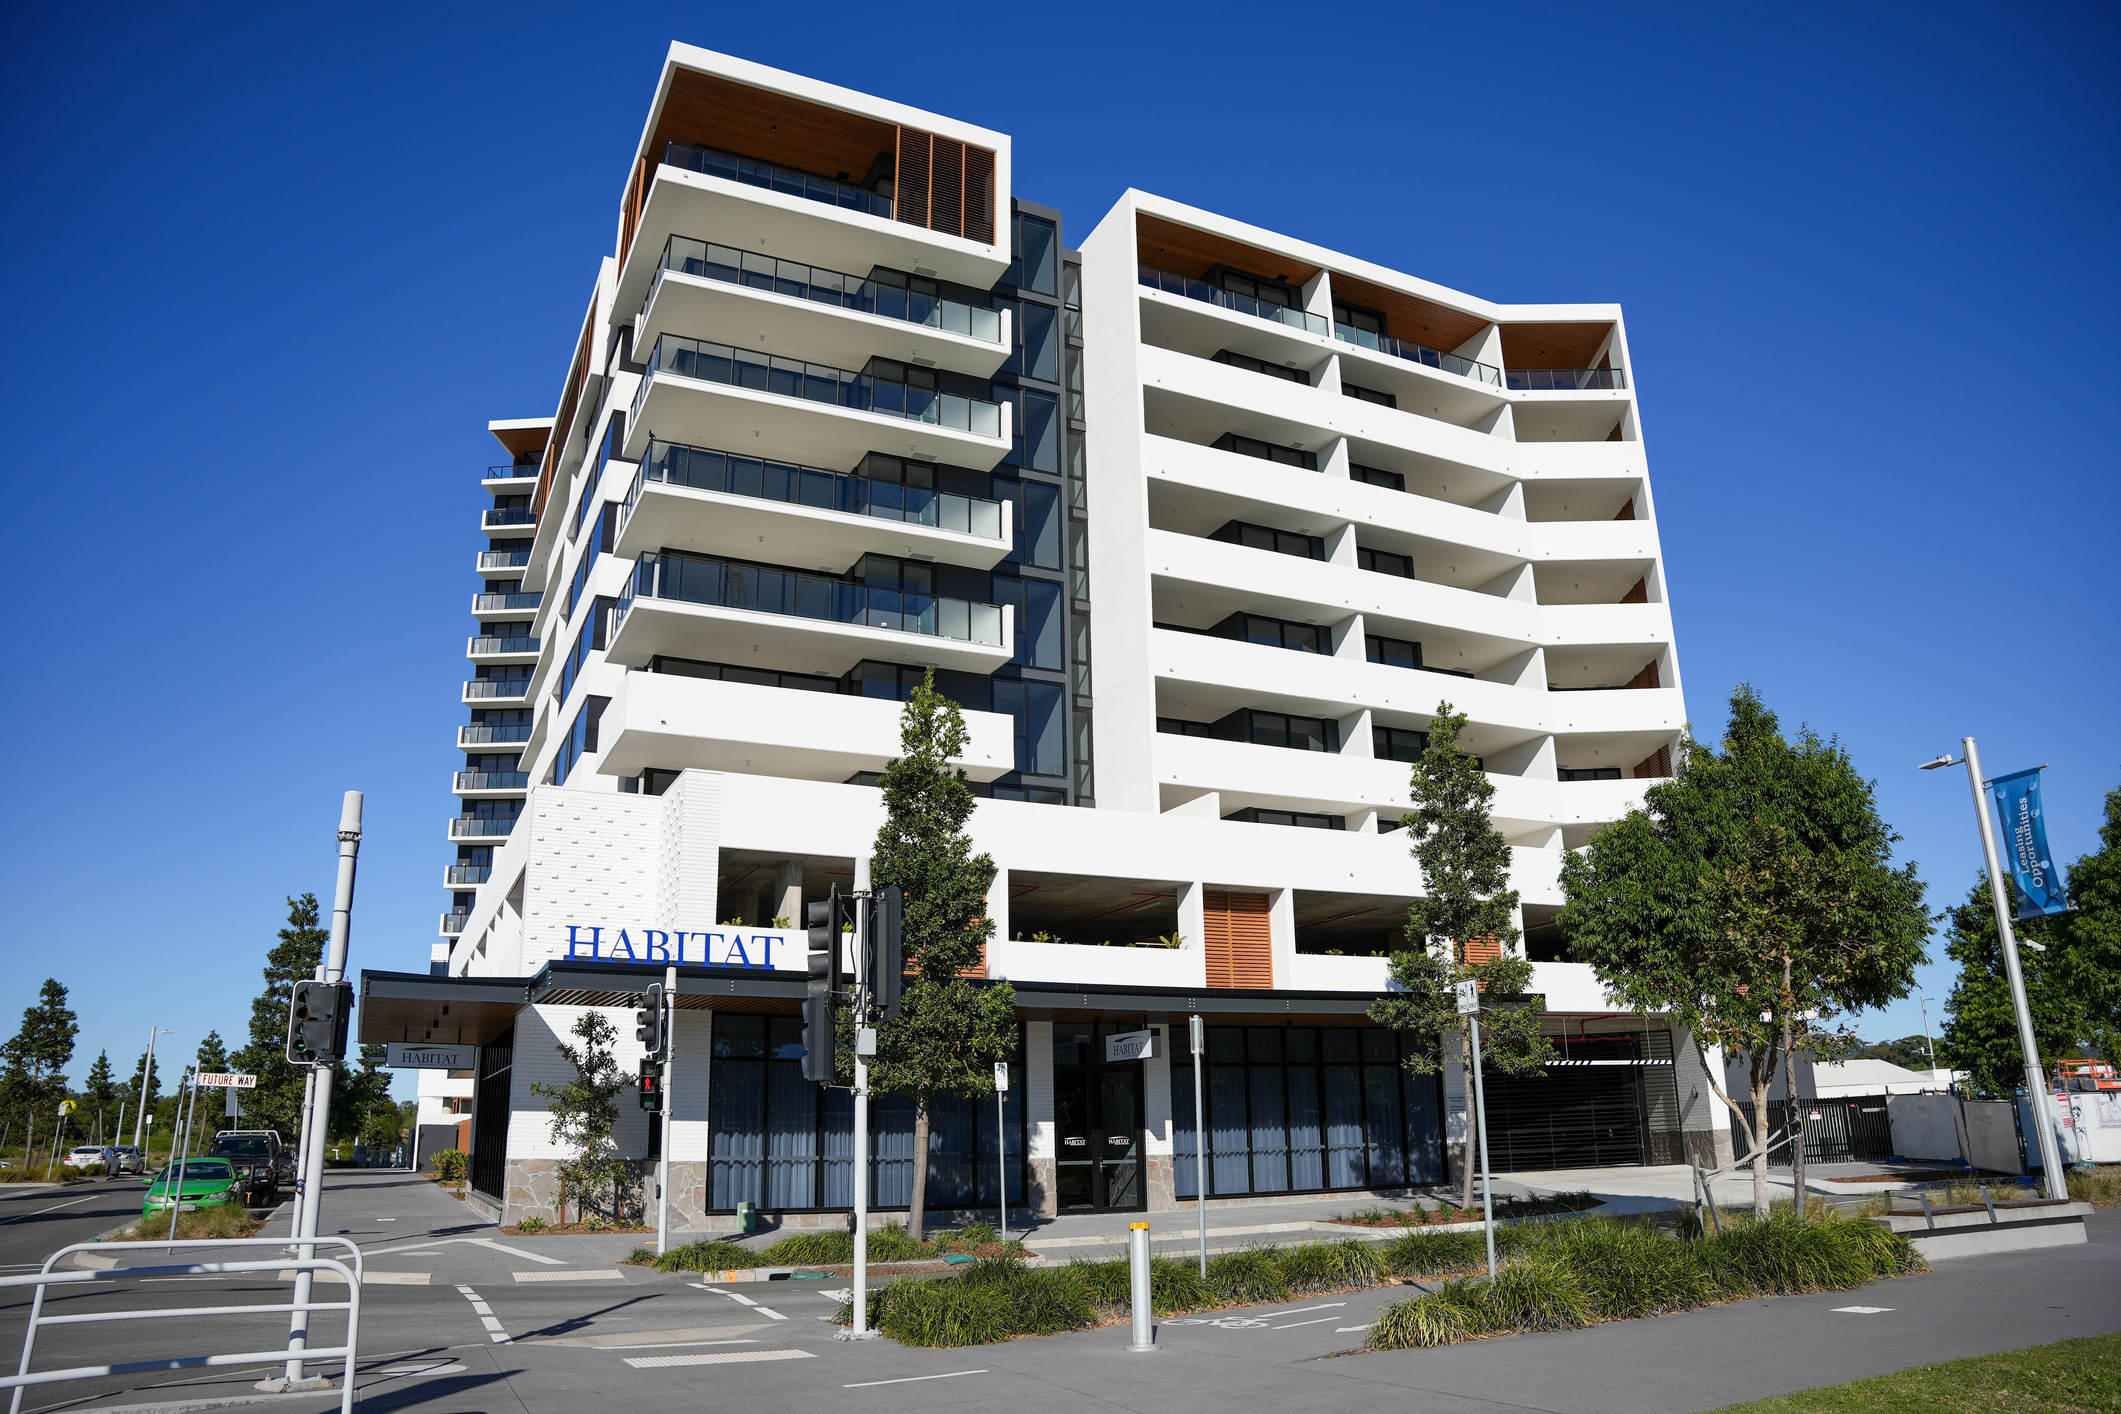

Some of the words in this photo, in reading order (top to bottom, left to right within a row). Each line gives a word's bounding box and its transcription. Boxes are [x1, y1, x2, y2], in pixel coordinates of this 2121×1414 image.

[2014, 827, 2030, 875] Leasing
[2019, 797, 2043, 888] Opportunities
[563, 925, 784, 970] HABITAT
[402, 1052, 460, 1065] HABITAT
[1113, 1041, 1144, 1057] HABITAT
[202, 1074, 234, 1086] FUTURE
[238, 1075, 255, 1086] WAY
